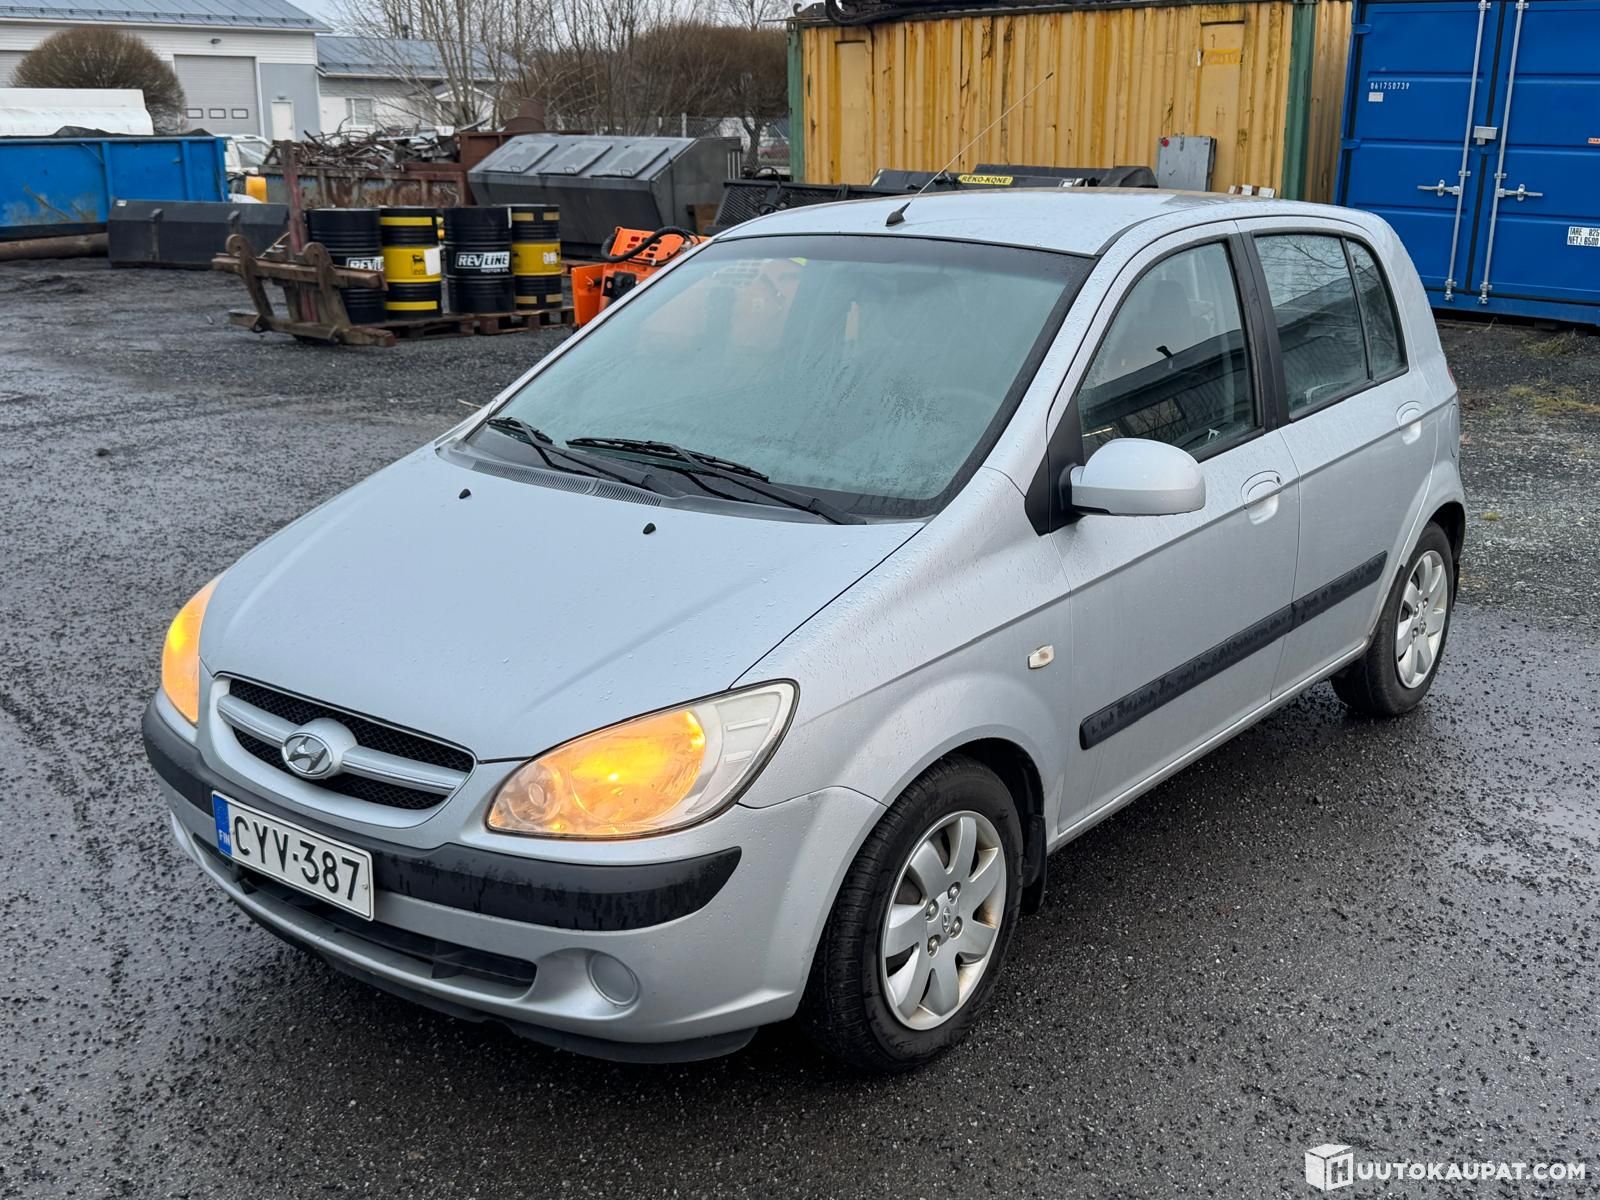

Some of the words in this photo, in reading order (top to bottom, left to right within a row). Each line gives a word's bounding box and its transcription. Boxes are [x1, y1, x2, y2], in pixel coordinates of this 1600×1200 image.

[961, 176, 1009, 184] REKO-KONE
[219, 829, 230, 846] FIN
[234, 815, 361, 902] CYV-387
